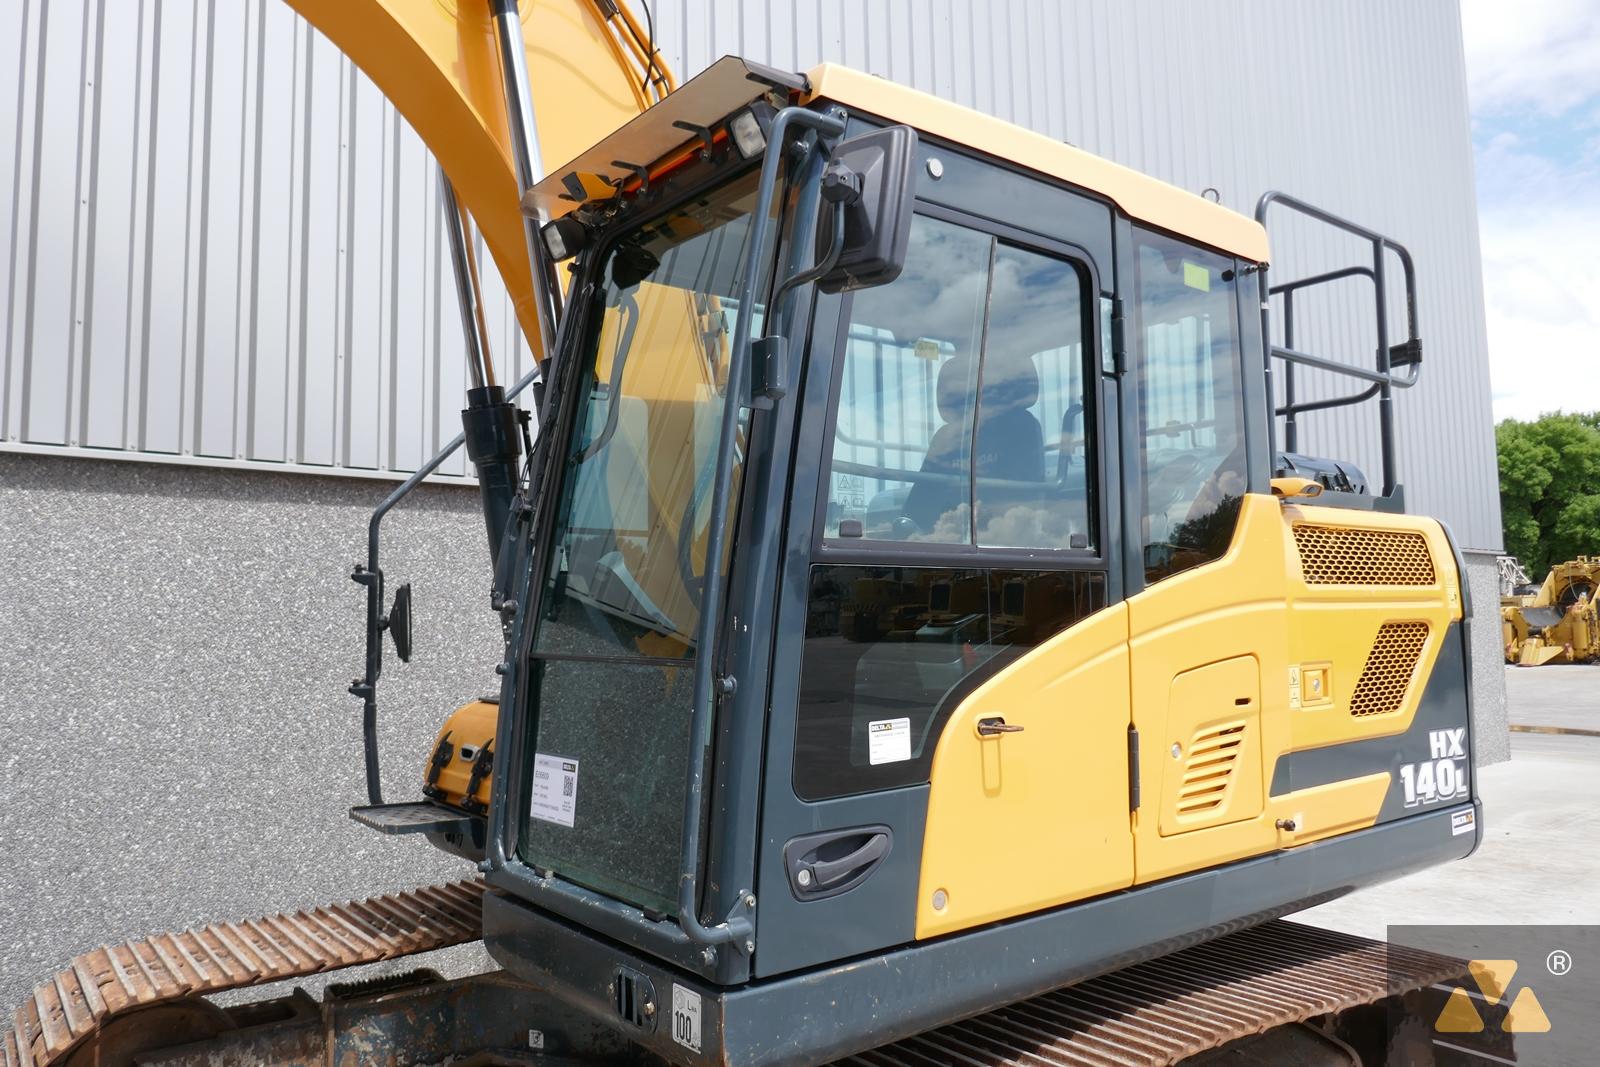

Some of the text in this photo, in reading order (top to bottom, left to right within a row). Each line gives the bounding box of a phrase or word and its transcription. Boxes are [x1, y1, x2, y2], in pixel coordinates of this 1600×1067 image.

[1429, 728, 1466, 760] HX
[1400, 759, 1467, 808] 140L
[675, 1010, 692, 1044] 100
